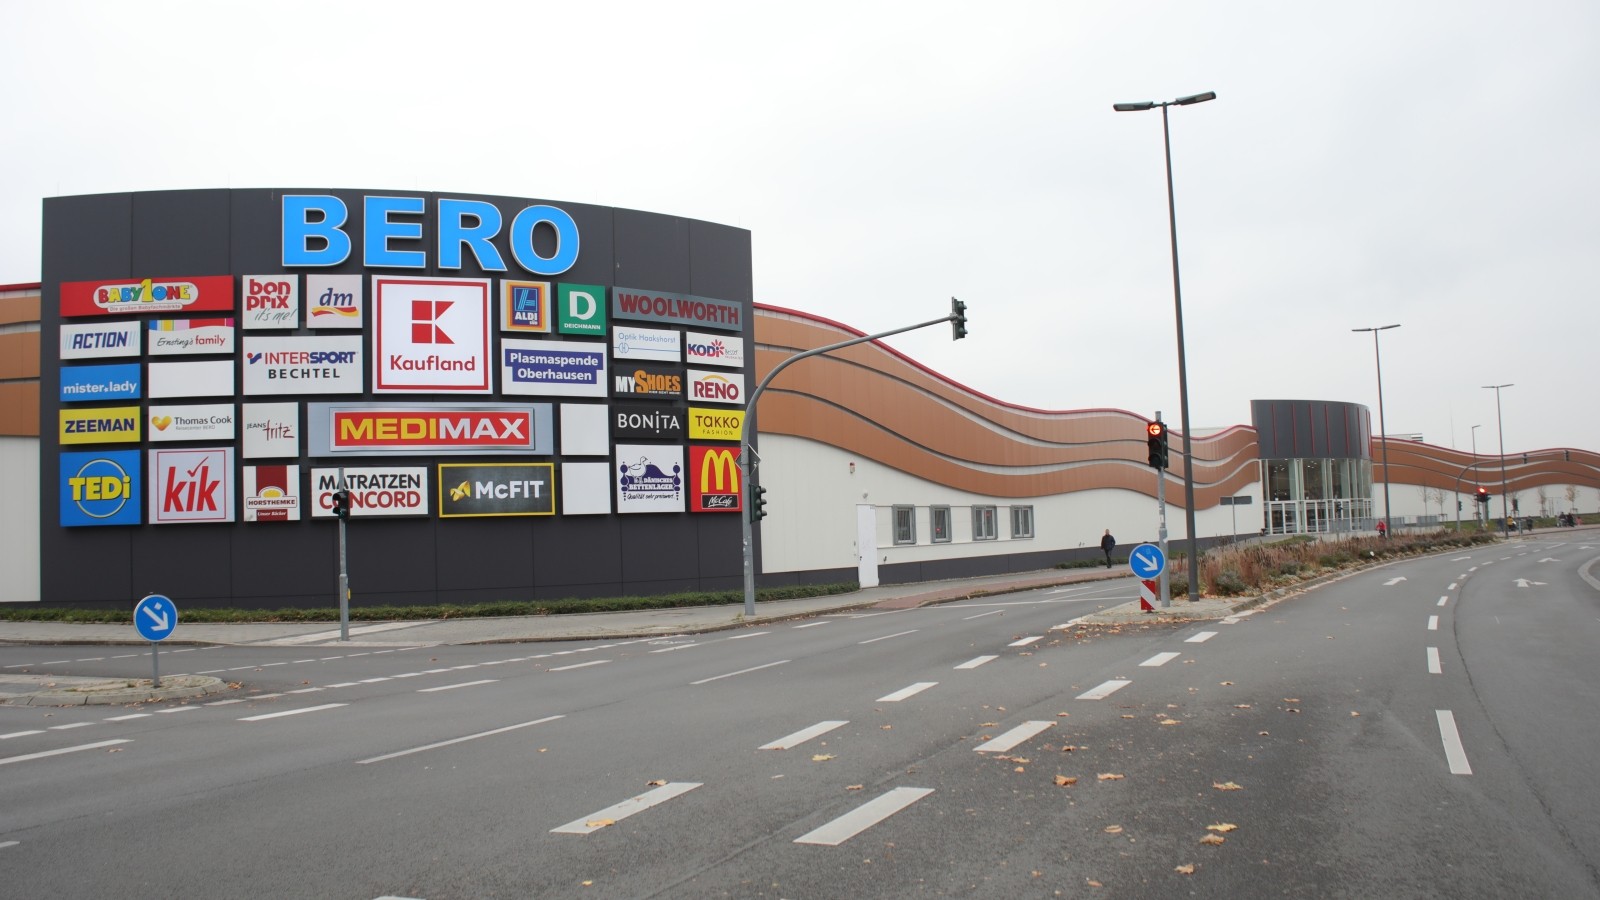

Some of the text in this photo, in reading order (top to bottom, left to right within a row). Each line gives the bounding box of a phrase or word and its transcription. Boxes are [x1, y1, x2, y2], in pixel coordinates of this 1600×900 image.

[281, 194, 580, 276] BERO
[249, 278, 291, 295] bon
[246, 295, 289, 311] prix
[319, 287, 353, 306] dm
[514, 311, 538, 321] ALDI
[618, 293, 739, 325] WOOLWORTH
[72, 331, 128, 349] ACTION
[156, 335, 226, 349] Ernsting's family
[618, 332, 637, 341] Optik
[264, 351, 356, 365] INTERSPORT
[390, 354, 475, 371] Kaufland
[510, 352, 599, 367] Plasmaspende
[268, 368, 340, 379] BECHTEL
[517, 368, 592, 381] Oberhausen
[694, 380, 739, 400] RENO
[65, 418, 135, 433] ZEEMAN
[174, 416, 232, 425] Thomas Cook
[340, 417, 525, 440] MEDIMAX
[262, 419, 295, 441] fritz
[68, 475, 131, 501] TEDi
[475, 480, 544, 500] McFIT
[248, 498, 295, 506] HORSTHEMKE
[319, 490, 421, 510] CNCORD
